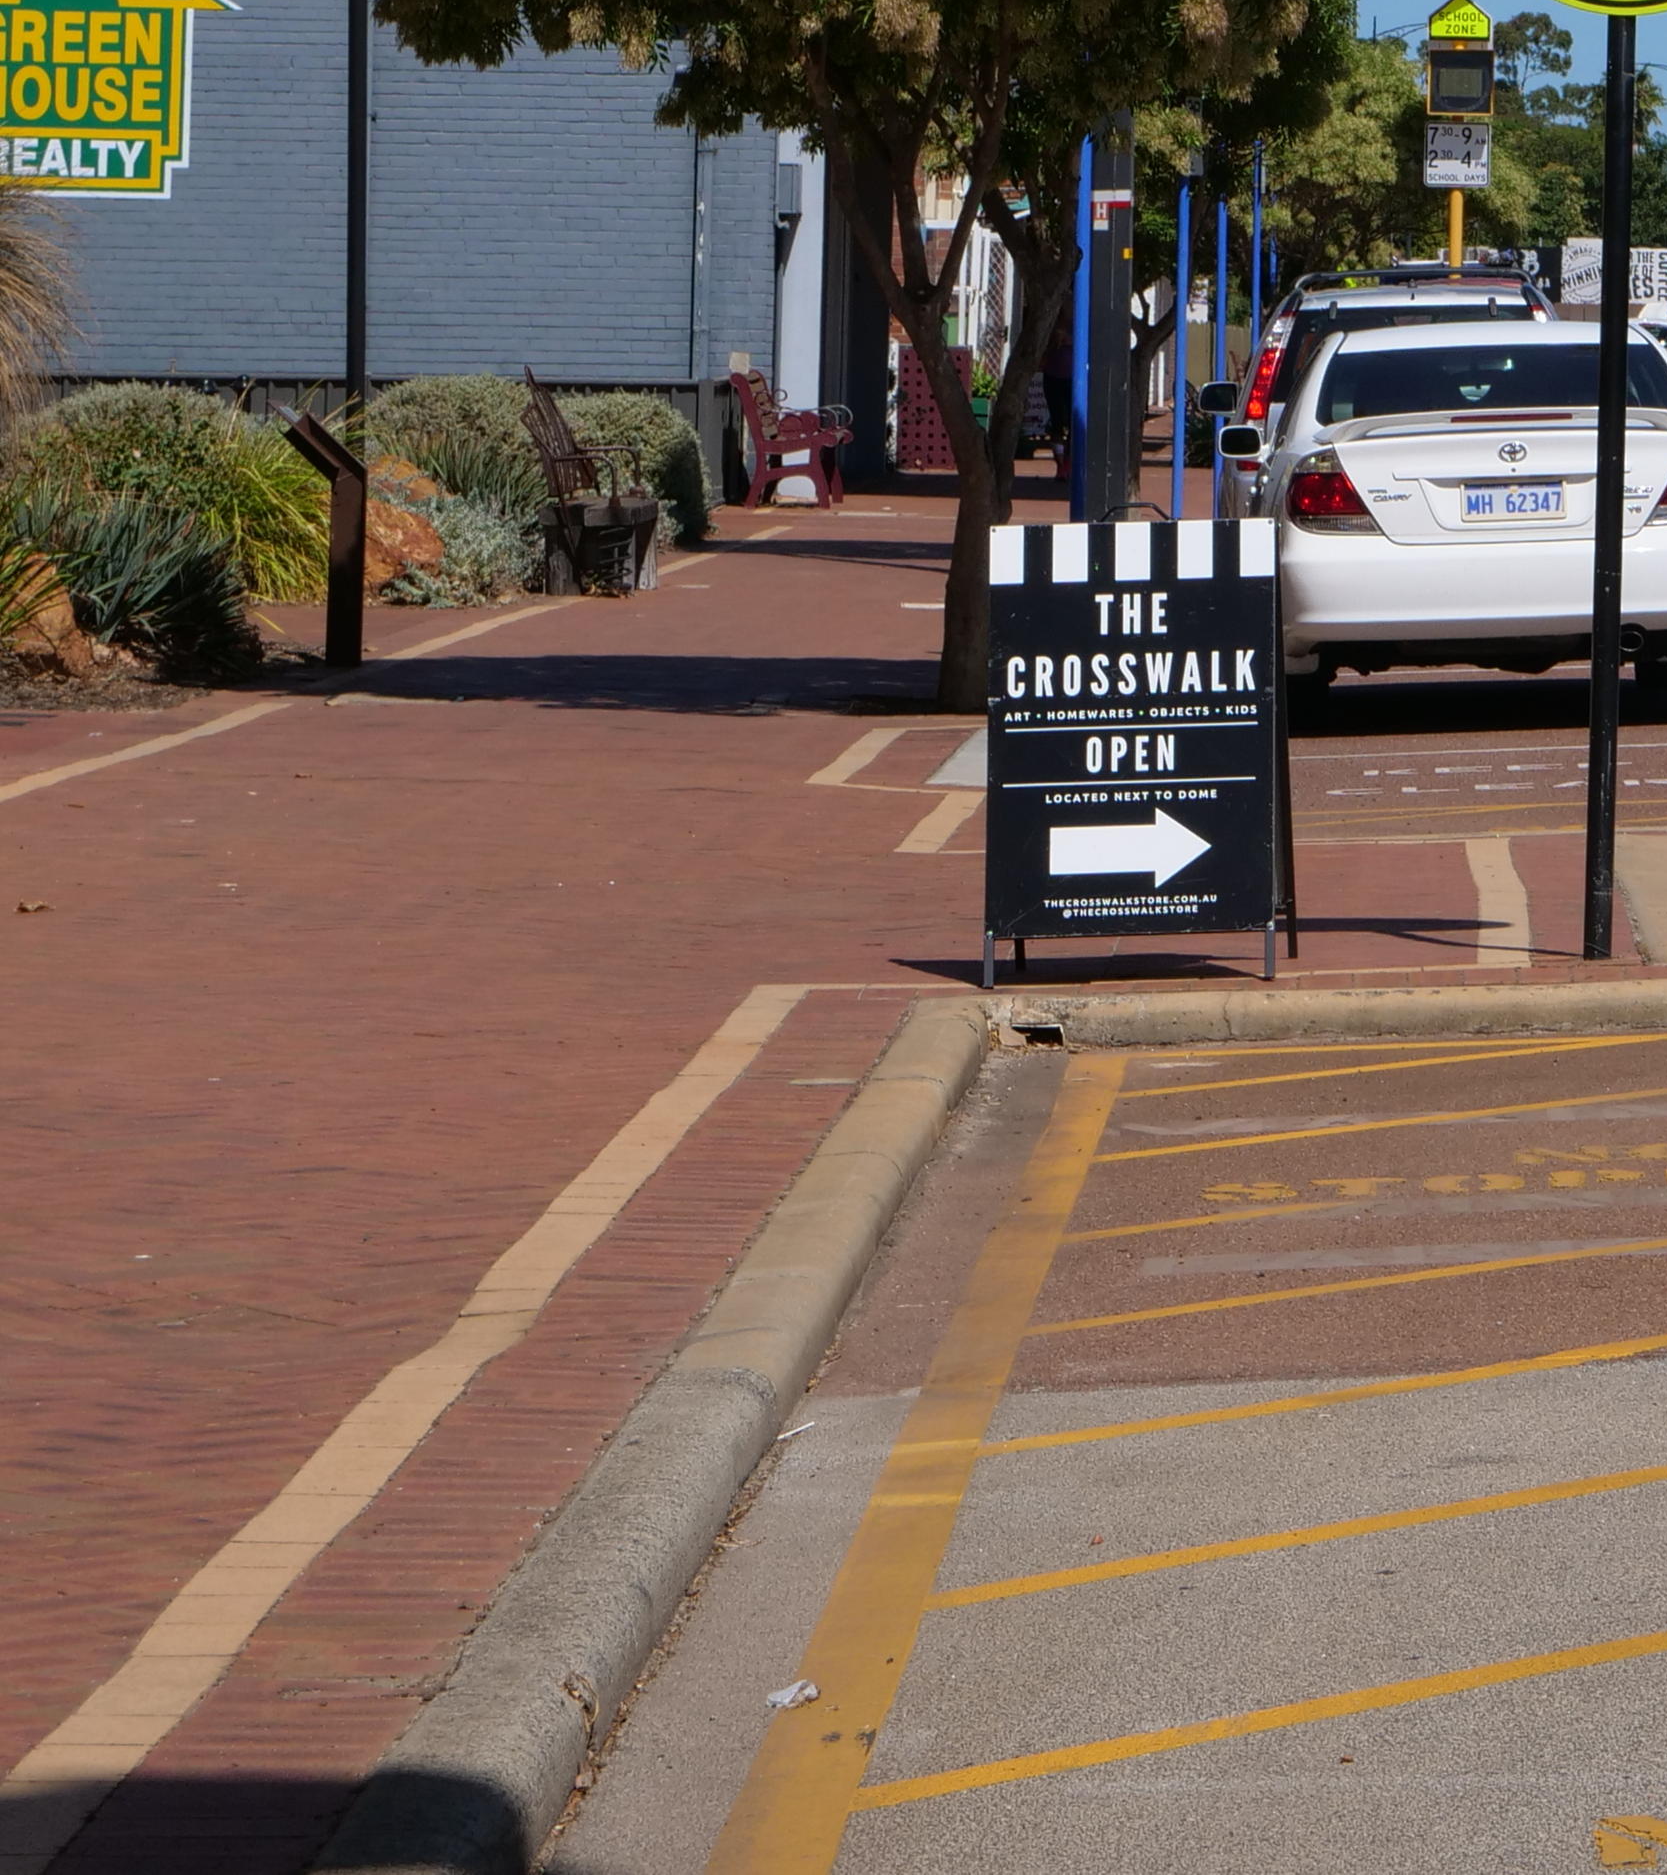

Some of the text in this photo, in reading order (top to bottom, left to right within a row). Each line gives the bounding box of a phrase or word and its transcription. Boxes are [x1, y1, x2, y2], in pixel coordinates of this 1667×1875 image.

[1437, 11, 1485, 23] SCHOOL
[0, 9, 162, 66] REEN
[1444, 24, 1478, 36] ZONE
[0, 65, 163, 123] OUSE
[1428, 172, 1487, 183] SCHOOL DAYS
[1637, 251, 1655, 264] THE
[1561, 265, 1602, 291] WINNI
[1466, 491, 1562, 515] MH 62347
[1094, 592, 1169, 636] THE
[1006, 649, 1256, 699] CROSSWALK
[1004, 704, 1258, 722] ART HOMEWARES OBJECTS KIDS
[1086, 734, 1176, 774] OPEN
[1045, 788, 1219, 804] LOCATED NEXT TO DOME
[1043, 893, 1218, 909] THECROSSWALKSTORE.COM.AU
[1062, 904, 1200, 920] @THECROSSWALKSTORE
